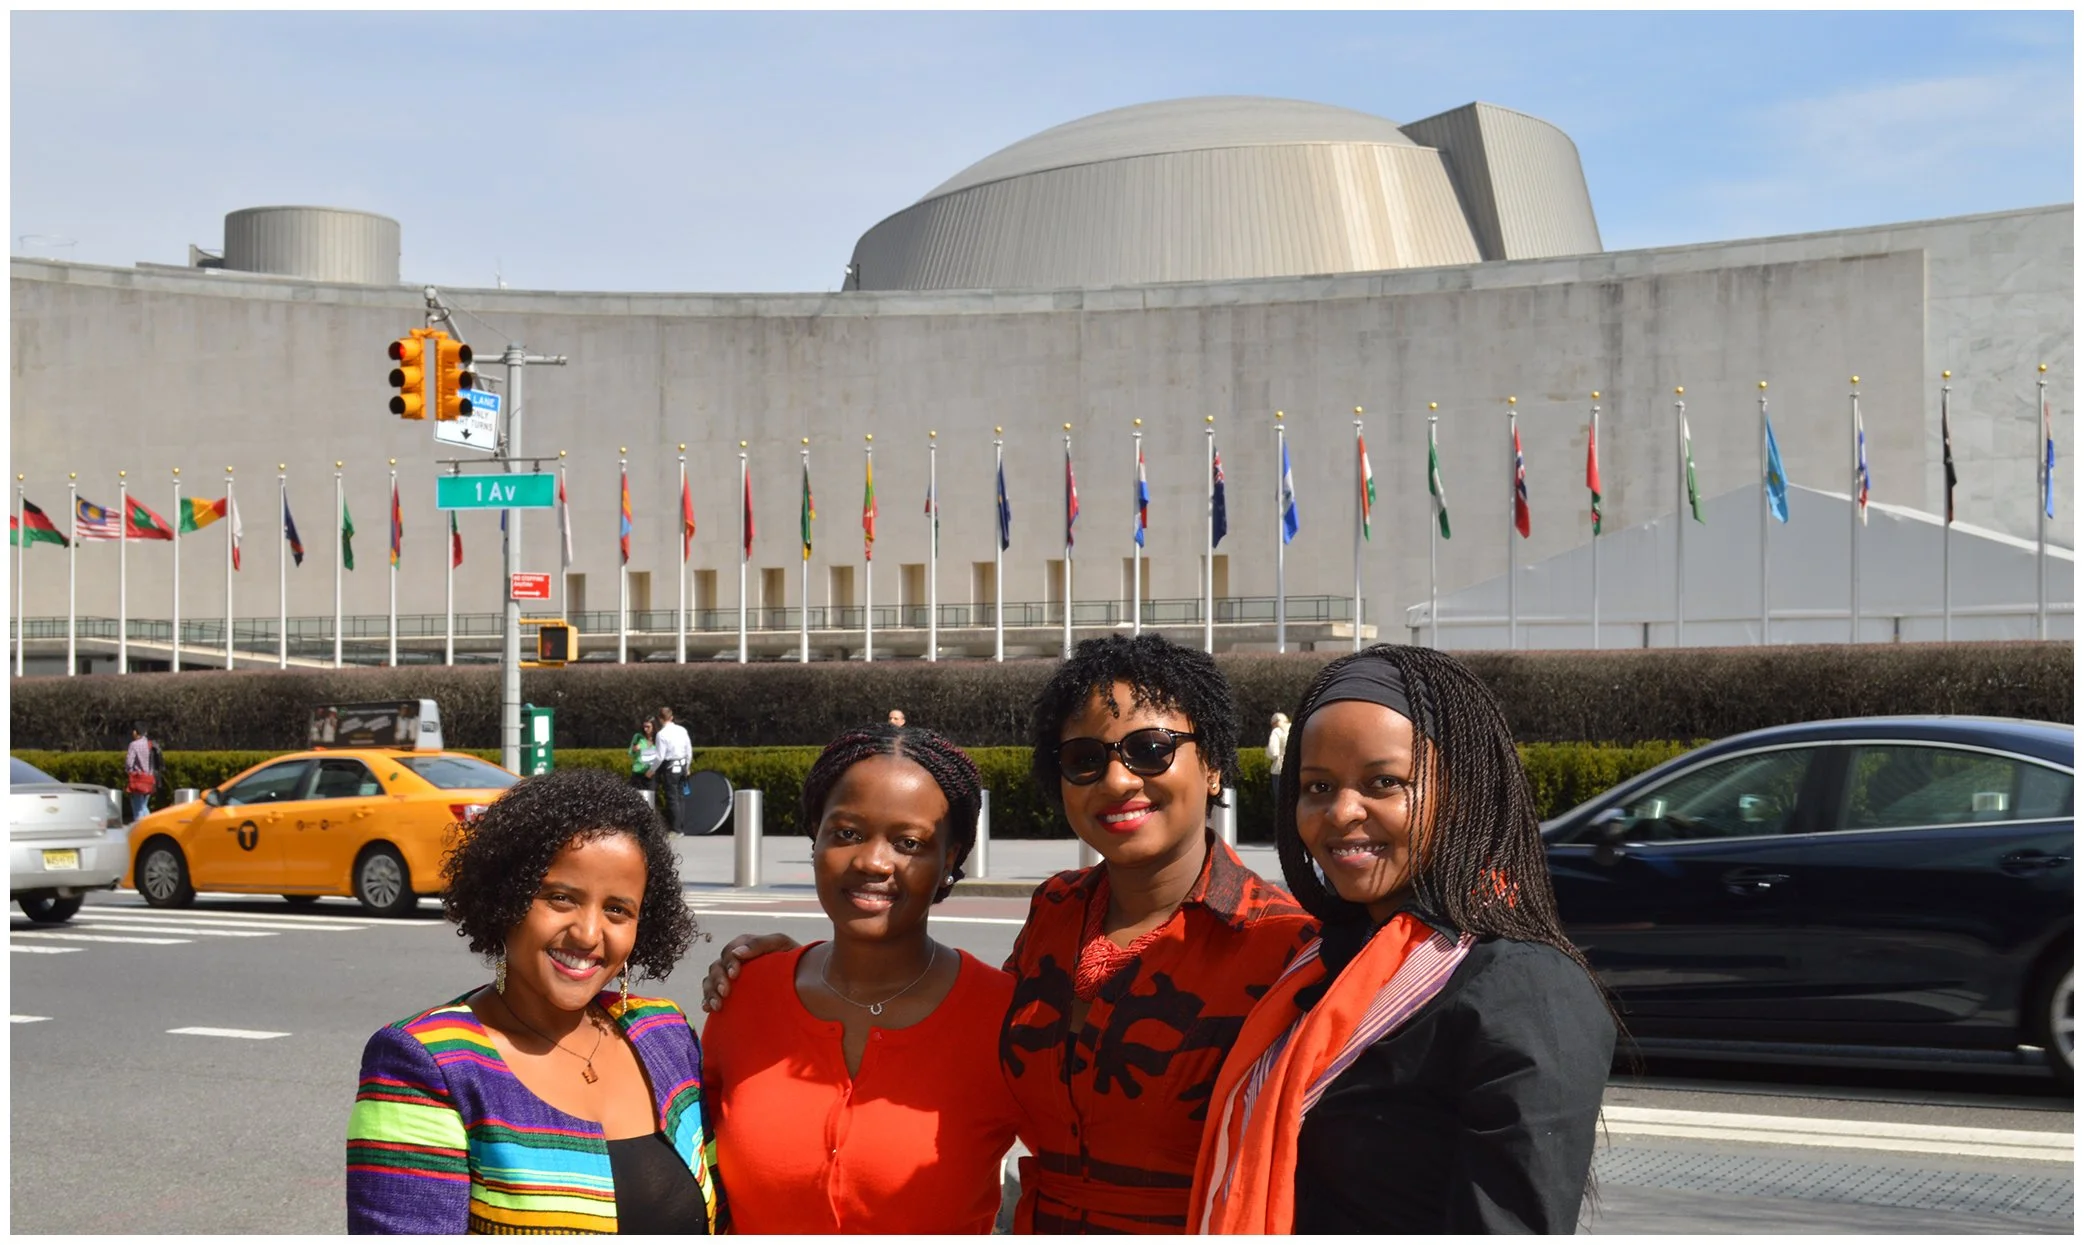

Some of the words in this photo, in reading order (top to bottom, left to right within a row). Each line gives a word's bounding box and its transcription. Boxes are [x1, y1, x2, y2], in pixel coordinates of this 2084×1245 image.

[472, 395, 496, 408] LANE
[471, 418, 493, 431] TURNS
[475, 481, 483, 502] 1
[487, 481, 517, 502] Av
